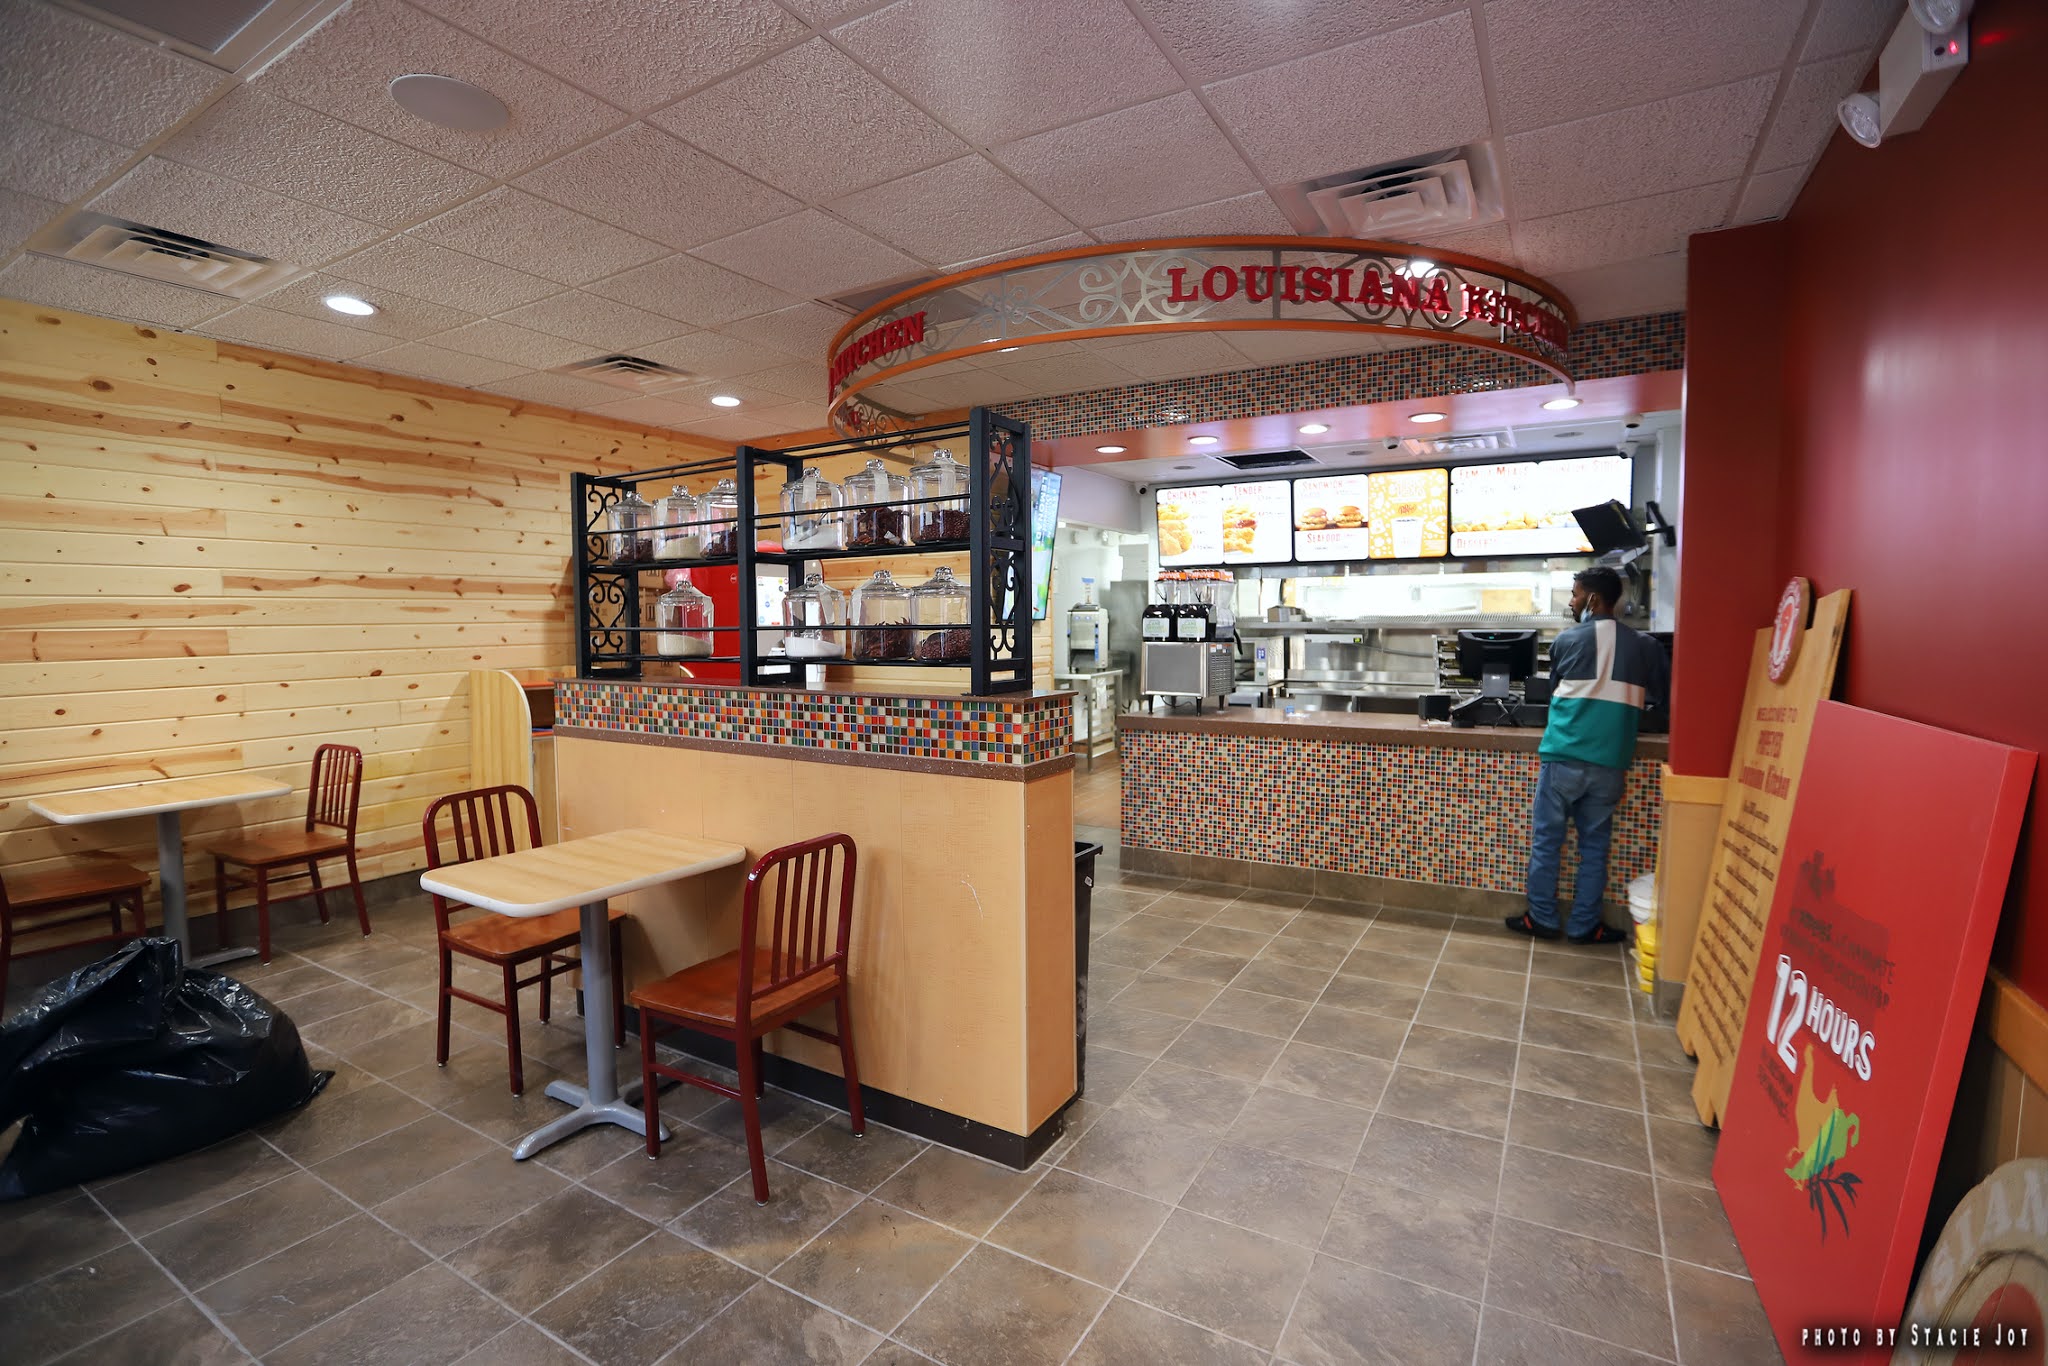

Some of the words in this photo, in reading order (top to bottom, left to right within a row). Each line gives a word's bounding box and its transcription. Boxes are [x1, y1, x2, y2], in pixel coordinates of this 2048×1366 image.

[1167, 265, 1453, 315] LOUISIANA
[1166, 489, 1198, 501] CHICKEN
[1766, 953, 1808, 1075] 12
[1805, 985, 1876, 1082] HOURS
